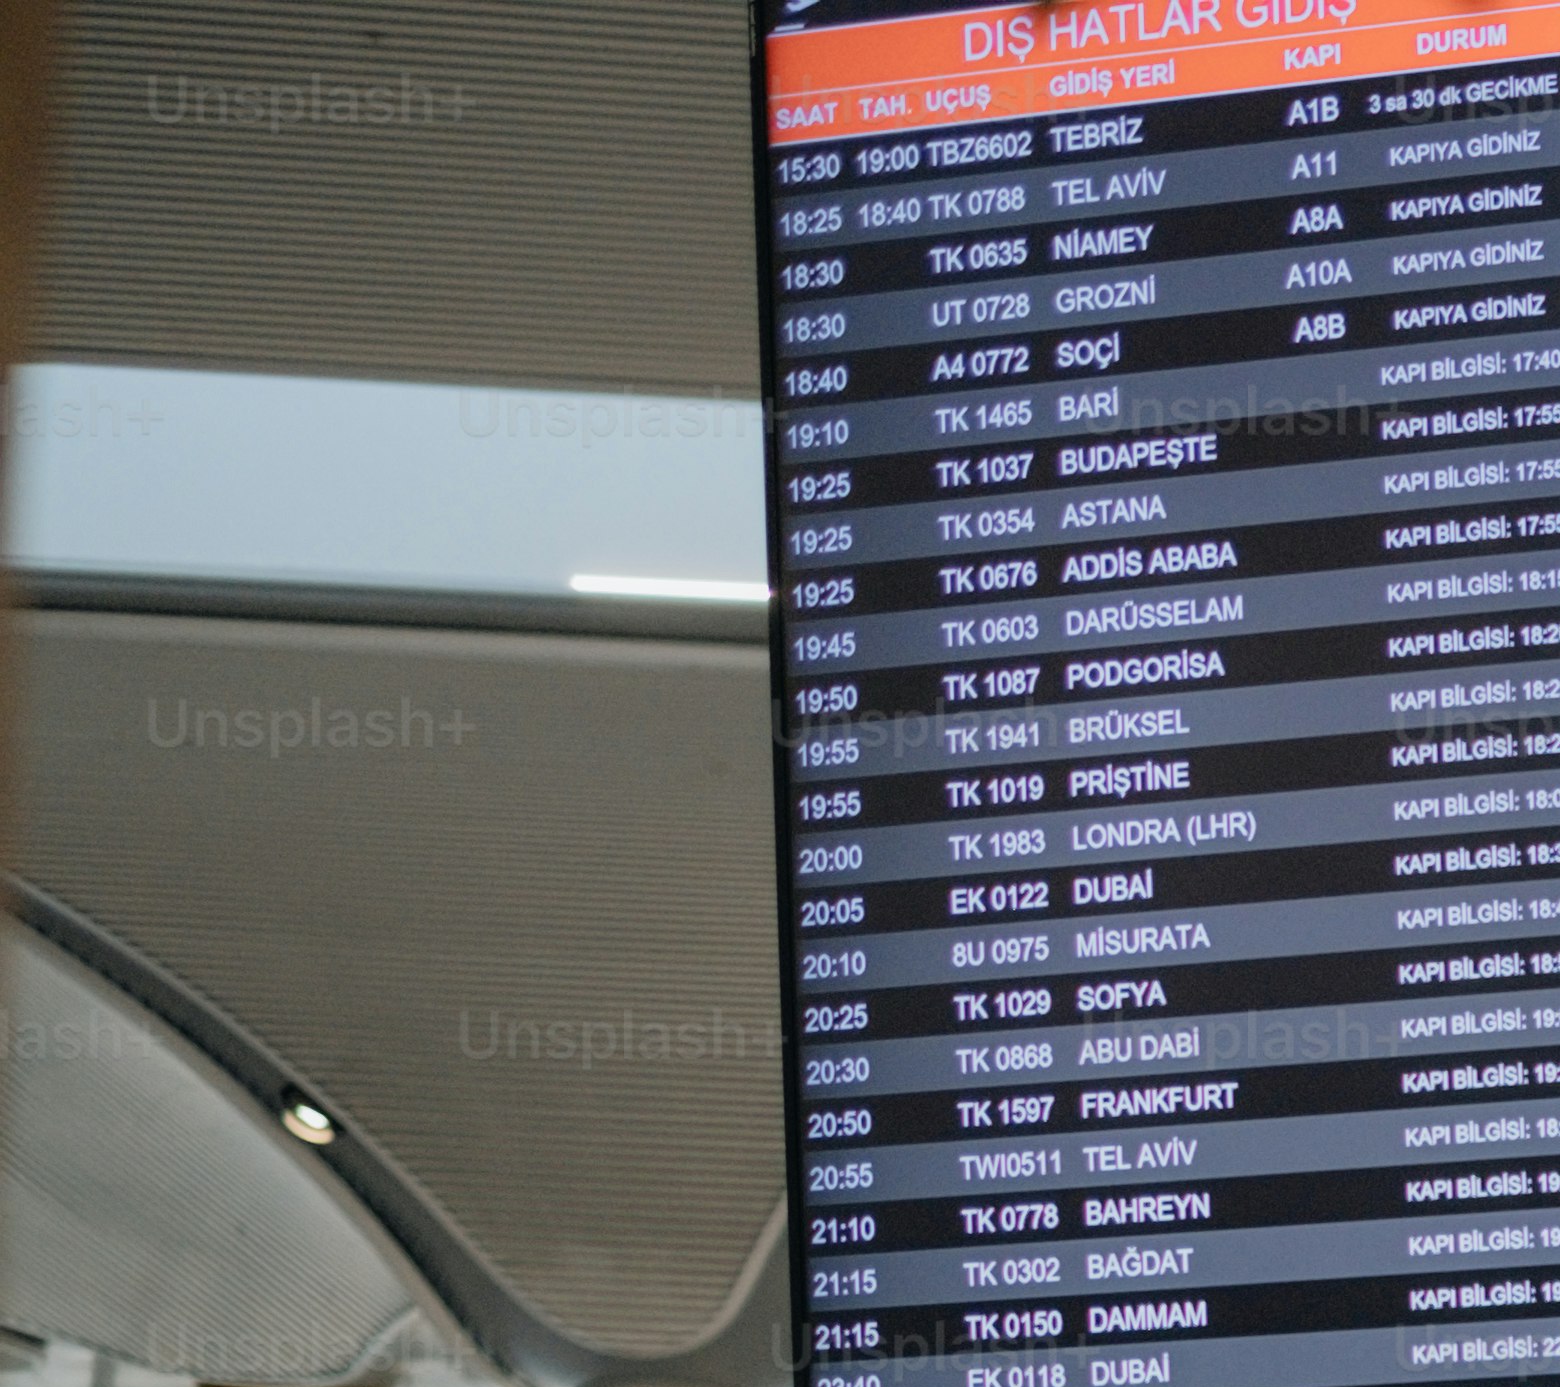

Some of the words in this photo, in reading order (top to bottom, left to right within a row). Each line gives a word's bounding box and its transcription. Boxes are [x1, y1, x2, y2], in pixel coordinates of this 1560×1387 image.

[776, 101, 839, 130] SAAT
[858, 93, 912, 121] TAH.
[925, 83, 992, 115] UÇUŞ
[1048, 66, 1114, 98] GİDİŞ
[1119, 58, 1176, 89] YERİ
[1283, 42, 1342, 71] KAPI
[1415, 23, 1508, 56] DURUM
[963, 16, 1035, 64] DIŞ
[1049, 0, 1223, 52] HATLAR
[777, 153, 841, 183] 15:30
[856, 145, 920, 175] 19:00
[925, 130, 1033, 167] TBZ6602
[1049, 114, 1144, 153] TEBRİZ
[1286, 94, 1340, 127] A1B
[1368, 94, 1382, 115] 3
[1384, 96, 1408, 113] sa
[1410, 88, 1436, 110] 30
[1437, 85, 1463, 107] dk
[1464, 73, 1559, 103] GECİKME
[808, 1108, 872, 1139] 20:50
[956, 1100, 993, 1128] TK
[997, 1095, 1055, 1125] 1597
[1080, 1081, 1239, 1119] FRANKFURT
[1401, 1070, 1450, 1094] KAPI
[1451, 1061, 1530, 1091] BİLGİSİ:
